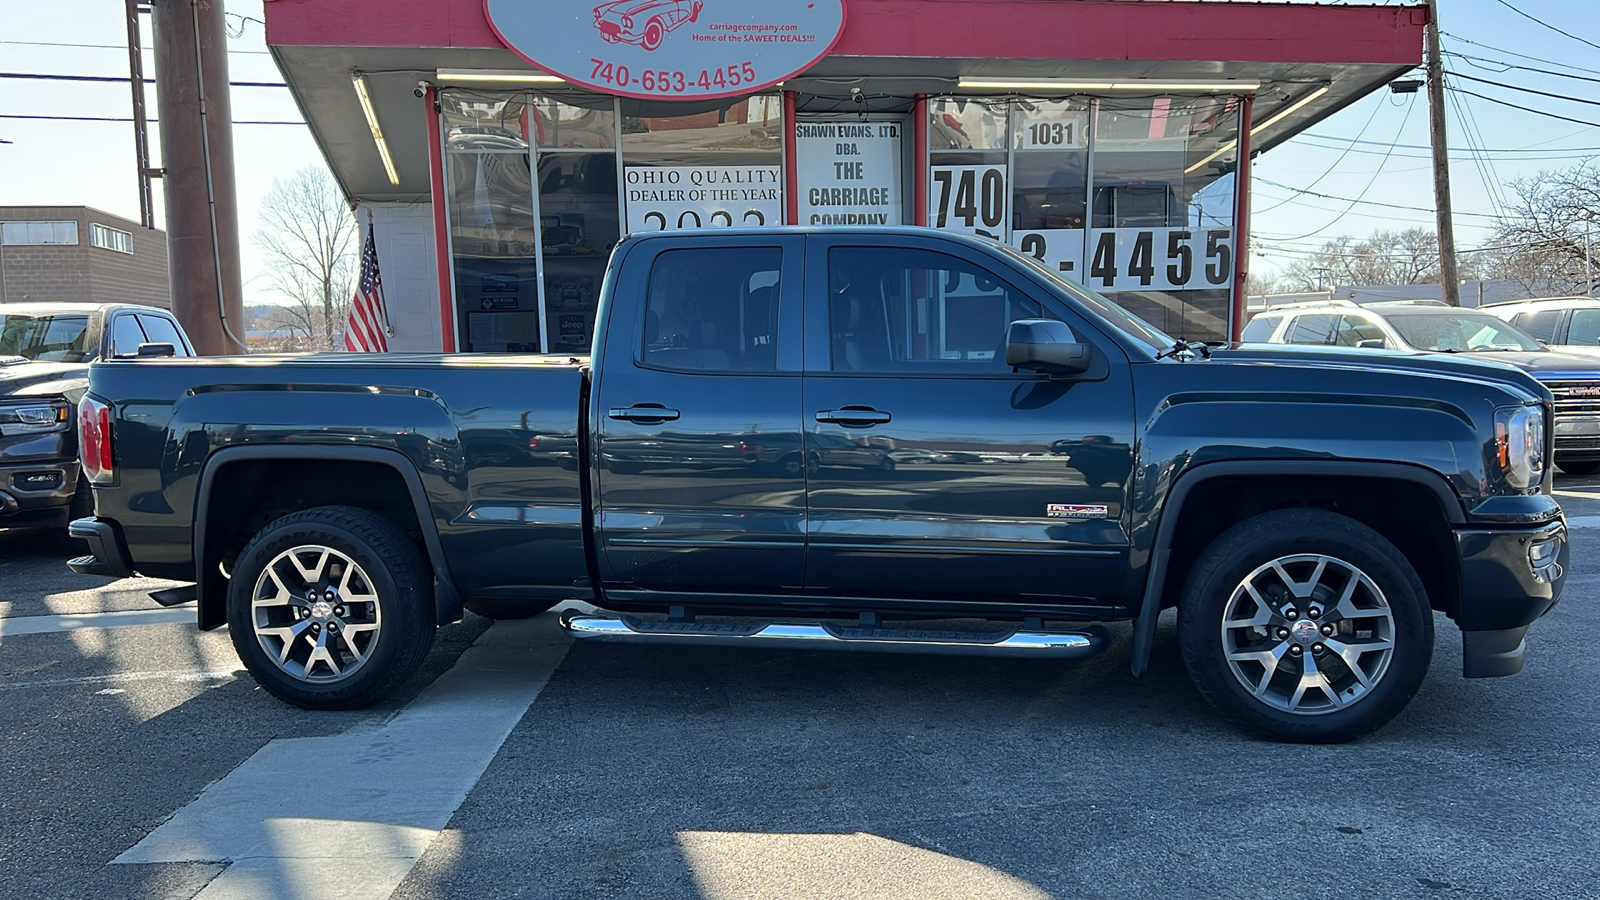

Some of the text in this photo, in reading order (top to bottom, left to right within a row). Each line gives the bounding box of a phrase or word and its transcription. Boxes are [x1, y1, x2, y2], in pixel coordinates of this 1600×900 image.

[709, 23, 798, 33] carriagecompany.com
[692, 34, 815, 43] Home of the SAWEET DEALS!!!
[590, 57, 756, 93] 740-653-4455
[796, 125, 899, 138] SHAWN EVANS. LTD.
[1029, 122, 1073, 145] 1031
[836, 143, 861, 155] DBA.
[627, 169, 780, 186] OHIO QUALITY
[834, 162, 863, 180] THE
[630, 188, 777, 202] DEALER OF THE YEAR
[809, 187, 889, 206] CARRIAGE
[934, 168, 1003, 228] 740
[810, 213, 888, 226] COMPANY
[562, 320, 583, 329] Jeep
